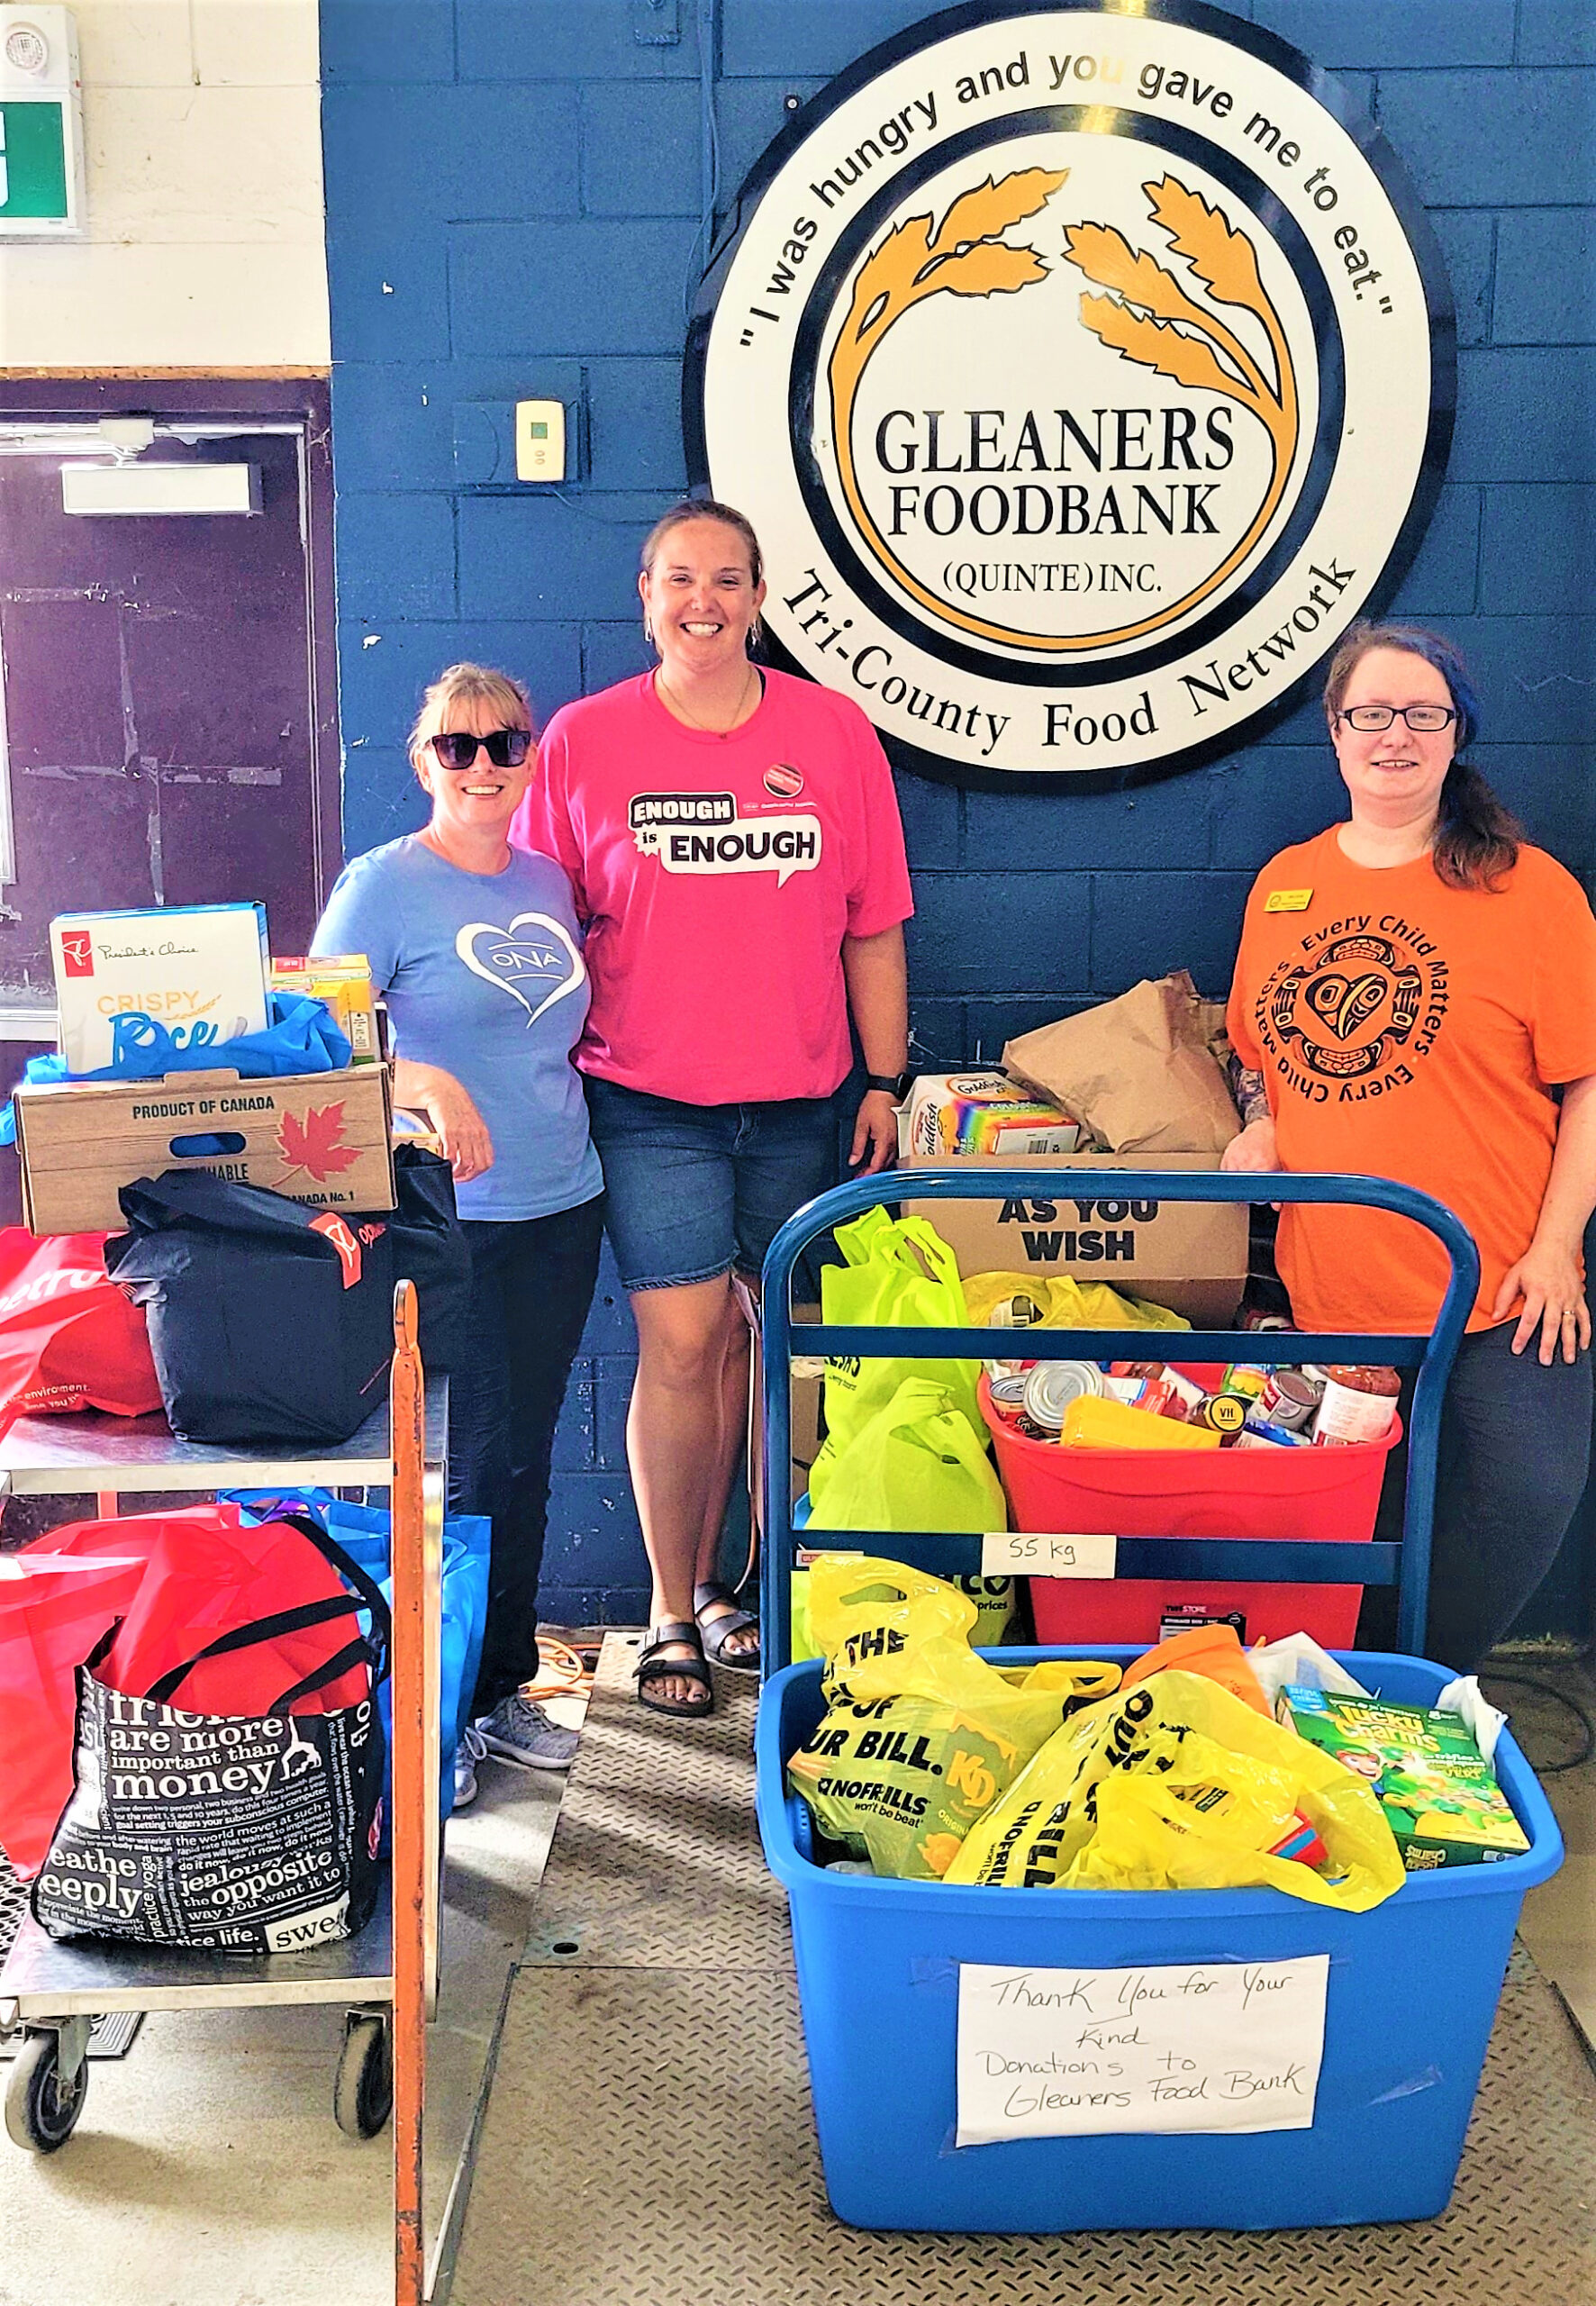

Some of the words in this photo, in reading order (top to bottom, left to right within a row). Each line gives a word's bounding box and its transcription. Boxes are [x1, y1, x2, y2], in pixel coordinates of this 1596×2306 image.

[766, 213, 817, 296] was
[812, 90, 939, 210] hungry
[956, 50, 1030, 105] and
[1048, 52, 1125, 90] you
[1139, 59, 1236, 120] gave
[1245, 109, 1303, 168] me
[1303, 166, 1339, 213] to
[875, 406, 1235, 475] GLEANERS
[887, 483, 1222, 538] FOODBANK
[782, 567, 1011, 757] Tri-County
[1042, 691, 1160, 748] Food
[1179, 553, 1356, 716] Network
[633, 801, 731, 822] ENOUGH
[642, 831, 657, 844] is
[670, 831, 815, 862] ENOUGH
[98, 946, 155, 960] President's
[158, 941, 199, 956] Choice
[492, 950, 562, 969] ONA
[96, 991, 200, 1014] CRISPY
[1301, 915, 1372, 951] Every
[1379, 915, 1437, 957] Child
[1412, 960, 1450, 1056] Matters
[1255, 960, 1290, 1056] Matters
[1278, 1057, 1329, 1103] Child
[1338, 1064, 1415, 1103] Every
[132, 1102, 195, 1119] PRODUCT
[199, 1100, 216, 1113] OF
[220, 1096, 275, 1112] CANADA
[349, 1191, 354, 1201] 1
[997, 1198, 1057, 1224] AS
[1080, 1198, 1159, 1222] YOU
[1021, 1230, 1135, 1261] WISH
[1220, 1407, 1235, 1418] VH
[1010, 1538, 1038, 1557] 55
[1050, 1540, 1075, 1565] kg
[977, 1601, 1008, 1611] prices
[845, 1628, 910, 1667] THE
[110, 1729, 170, 1752] are
[180, 1717, 284, 1752] more
[1335, 1718, 1441, 1753] Charms
[112, 1751, 222, 1774] important
[227, 1742, 281, 1762] than
[801, 1730, 849, 1757] UR
[854, 1731, 943, 1775] BILL.
[112, 1759, 276, 1800] money
[946, 1750, 996, 1808] KD
[831, 1780, 930, 1816] NOFRILLS
[855, 1802, 877, 1814] won't
[878, 1805, 893, 1819] be
[893, 1812, 924, 1829] beat
[167, 1818, 201, 1830] triggers
[202, 1817, 223, 1828] your
[224, 1802, 285, 1824] subconscious
[176, 1834, 196, 1846] the
[198, 1829, 234, 1844] world
[237, 1820, 277, 1837] moves
[280, 1814, 292, 1826] at
[294, 1802, 322, 1820] such
[324, 1801, 331, 1809] a
[178, 1862, 193, 1871] do
[195, 1859, 204, 1870] it
[285, 1838, 298, 1848] do
[300, 1834, 308, 1843] it
[221, 1838, 240, 1848] that
[241, 1830, 274, 1844] waiting
[275, 1828, 286, 1836] to
[49, 1848, 138, 1877] eathe
[141, 1855, 158, 1889] yoga
[211, 1851, 332, 1906] opposite
[37, 1873, 143, 1919] eeply
[187, 1909, 222, 1921] way
[226, 1897, 258, 1917] you
[261, 1882, 306, 1904] want
[308, 1875, 323, 1890] it
[323, 1867, 340, 1883] to
[141, 1892, 169, 1938] practice
[219, 1927, 260, 1946] life.
[1094, 1975, 1168, 2025] You
[1177, 1970, 1218, 1997] for
[1242, 1967, 1293, 2011] Your
[1075, 2028, 1149, 2050] Kind
[975, 2049, 1125, 2077] Donations
[1157, 2050, 1198, 2072] to
[1004, 2084, 1132, 2119] Gleaners
[1147, 2075, 1209, 2103] Food
